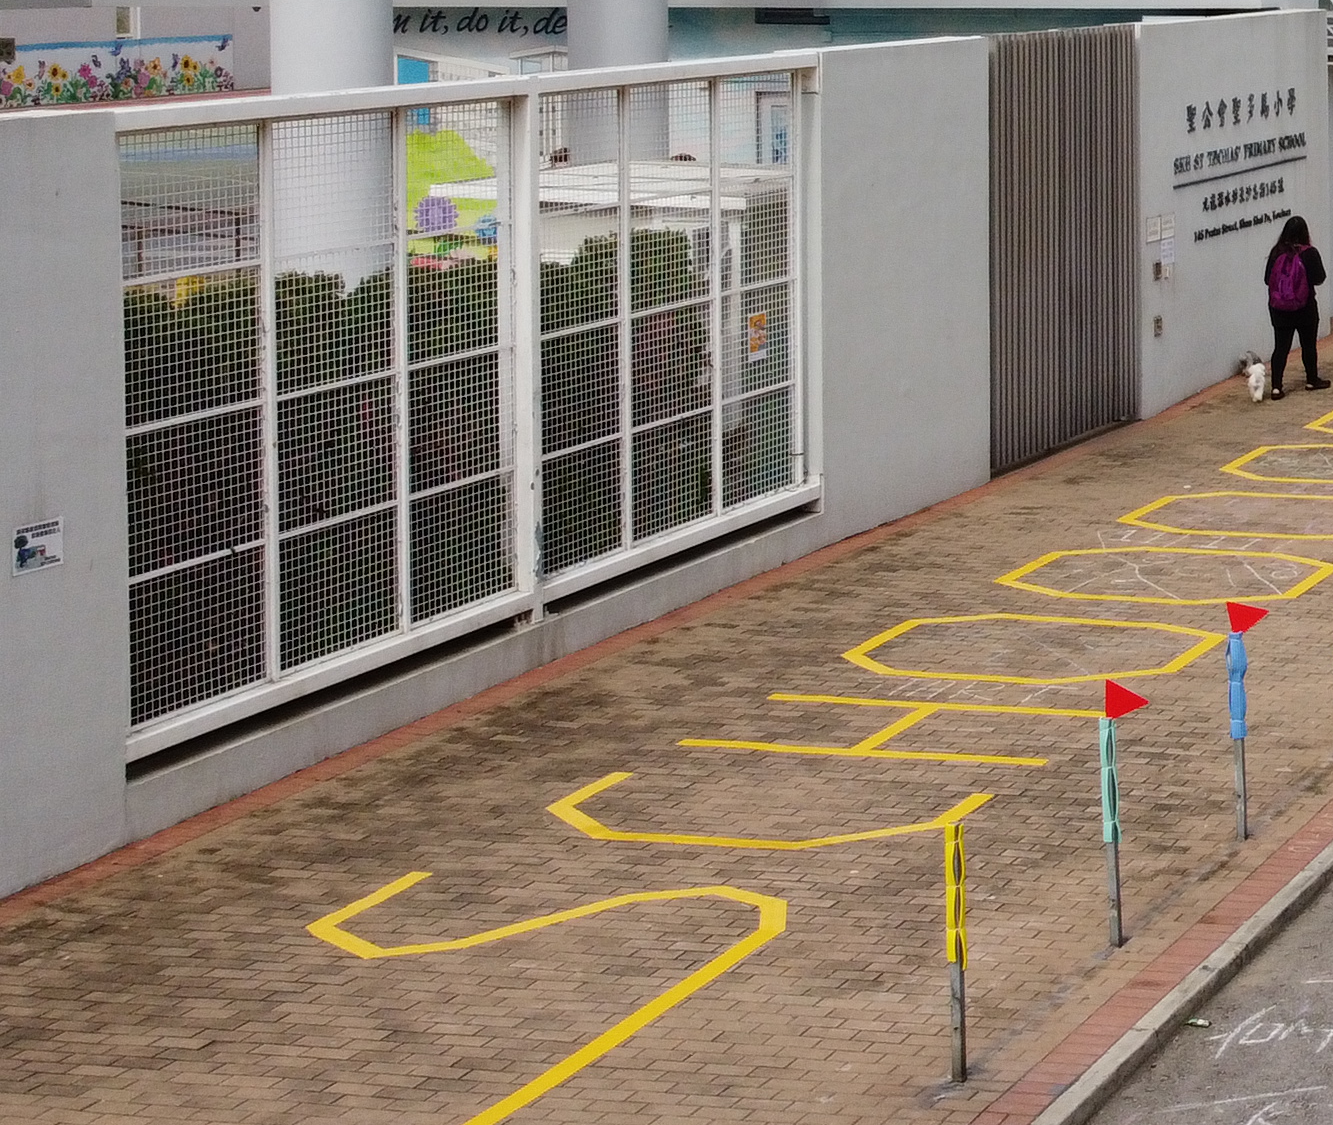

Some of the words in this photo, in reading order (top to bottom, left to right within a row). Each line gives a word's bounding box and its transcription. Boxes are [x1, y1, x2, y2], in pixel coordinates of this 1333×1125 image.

[419, 8, 449, 36] it,
[456, 6, 489, 33] do
[498, 8, 528, 37] it,
[1186, 87, 1297, 134] 聖公會聖多馬小學
[1243, 137, 1277, 160] PRIMARY
[1278, 132, 1306, 152] SCHOOL
